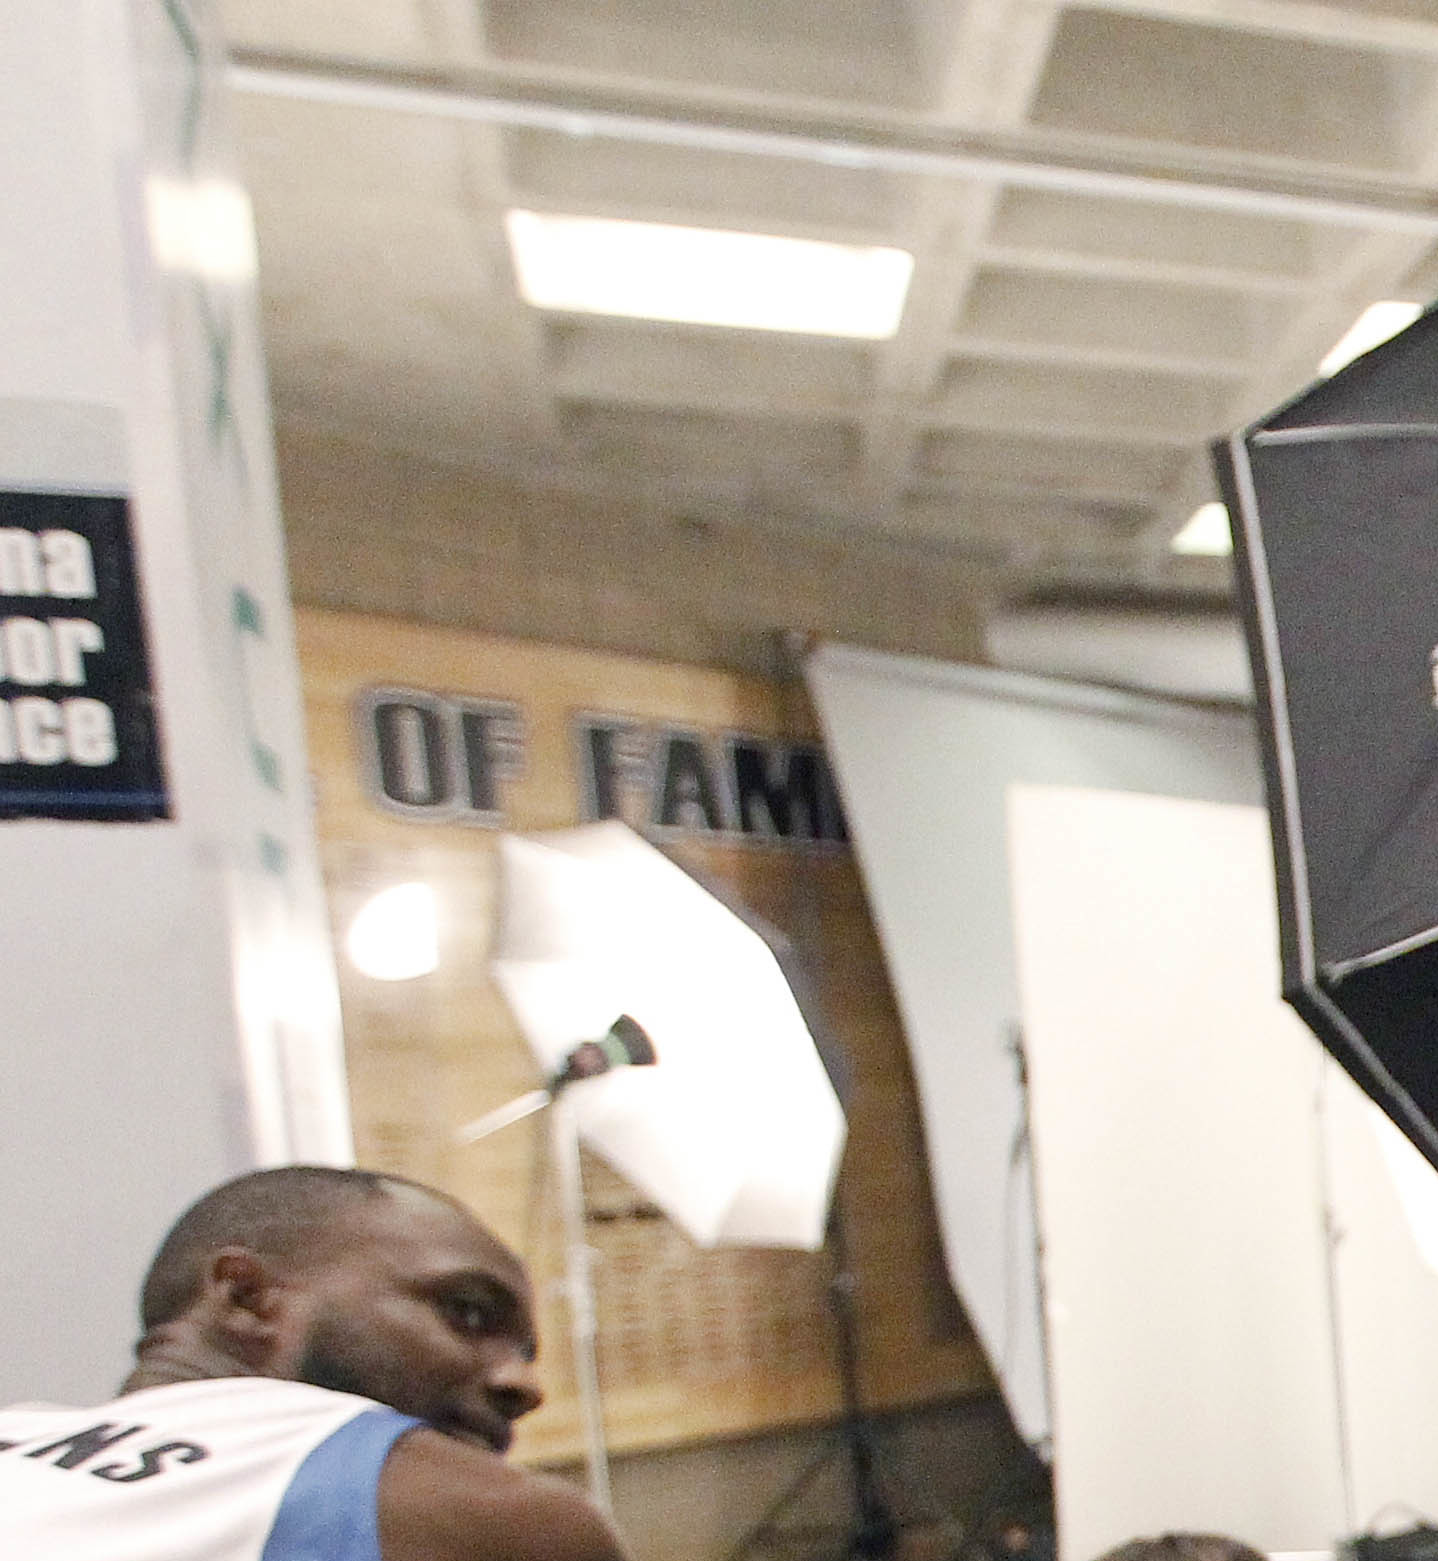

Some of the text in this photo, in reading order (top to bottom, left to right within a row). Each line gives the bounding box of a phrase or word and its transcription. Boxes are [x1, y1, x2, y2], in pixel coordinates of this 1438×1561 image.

[0, 614, 105, 686] or
[359, 688, 851, 845] OF FAM
[0, 1423, 210, 1483] NS
